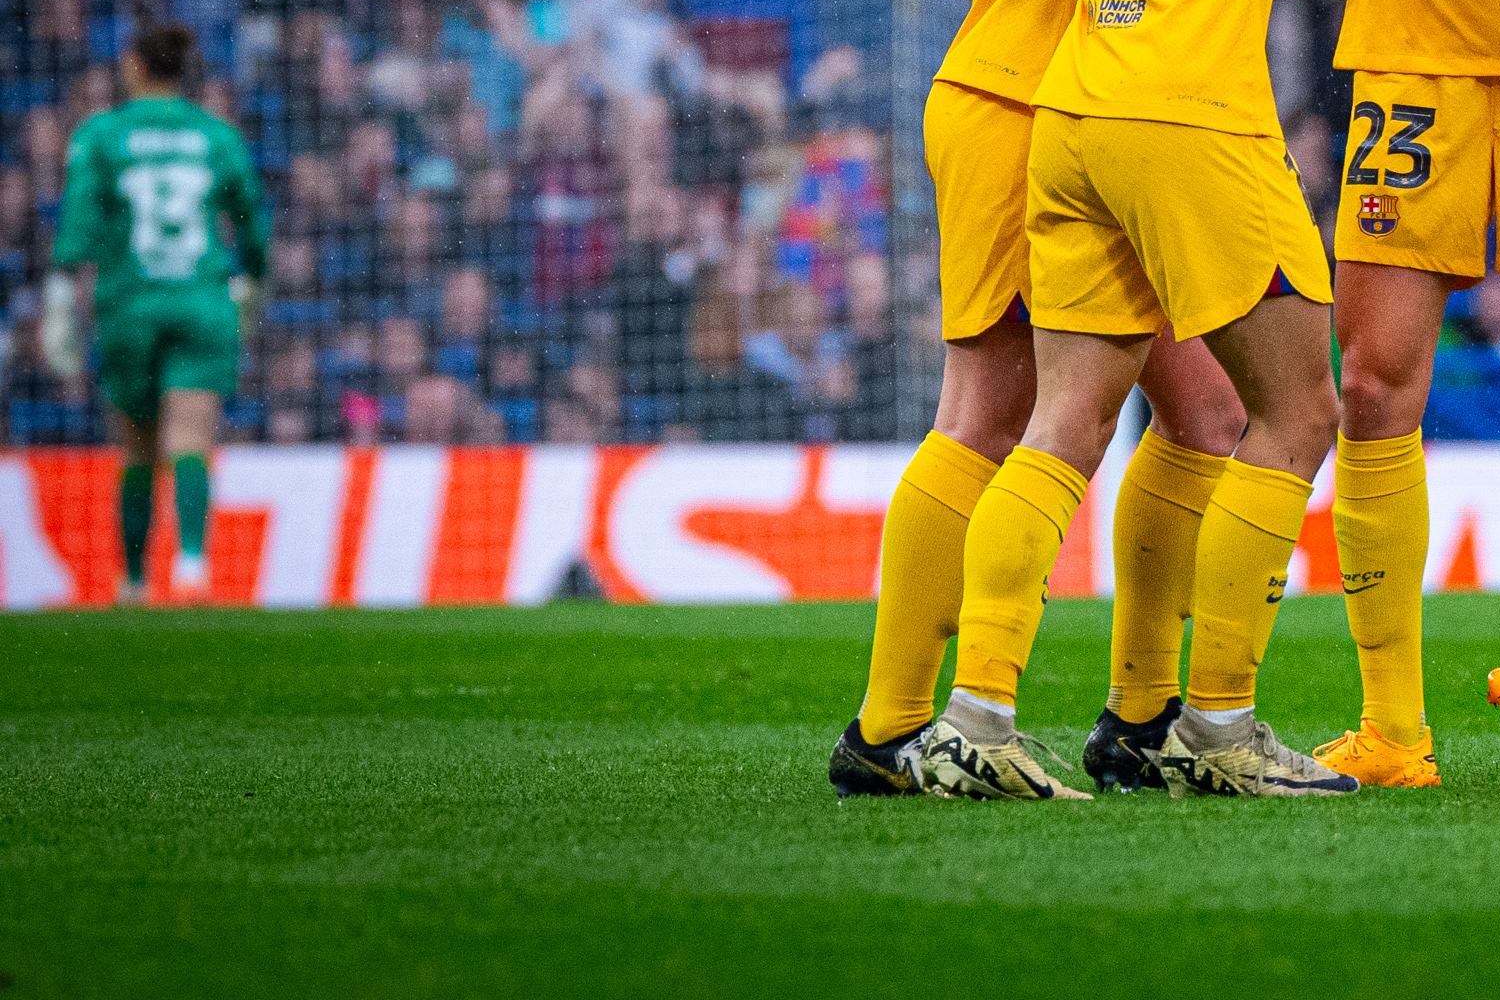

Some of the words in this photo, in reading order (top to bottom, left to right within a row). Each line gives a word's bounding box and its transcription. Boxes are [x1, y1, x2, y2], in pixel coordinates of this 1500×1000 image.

[1096, 11, 1143, 24] ACNUR
[1346, 101, 1437, 189] 23
[1341, 570, 1386, 582] arça
